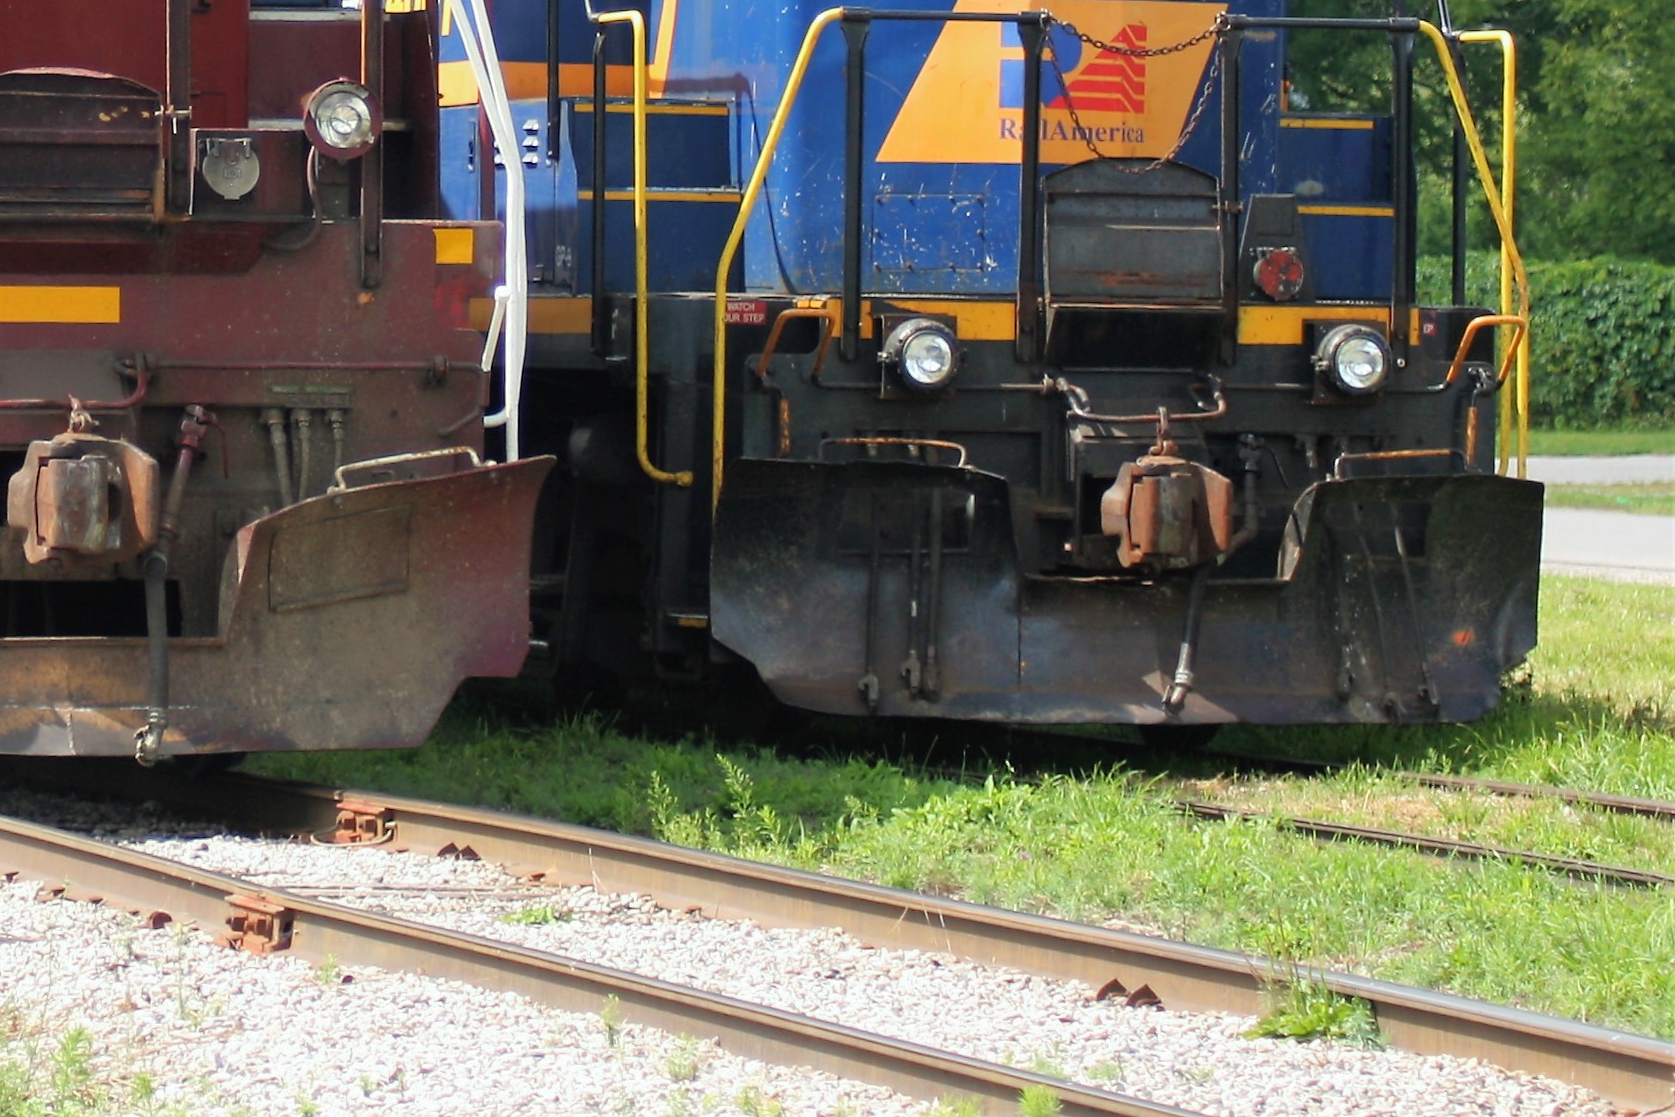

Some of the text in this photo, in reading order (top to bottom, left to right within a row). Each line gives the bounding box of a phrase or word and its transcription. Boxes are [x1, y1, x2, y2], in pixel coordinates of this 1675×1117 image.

[1000, 118, 1144, 143] RlAmerica
[727, 302, 756, 312] WATCH
[725, 312, 765, 322] OUR STEP
